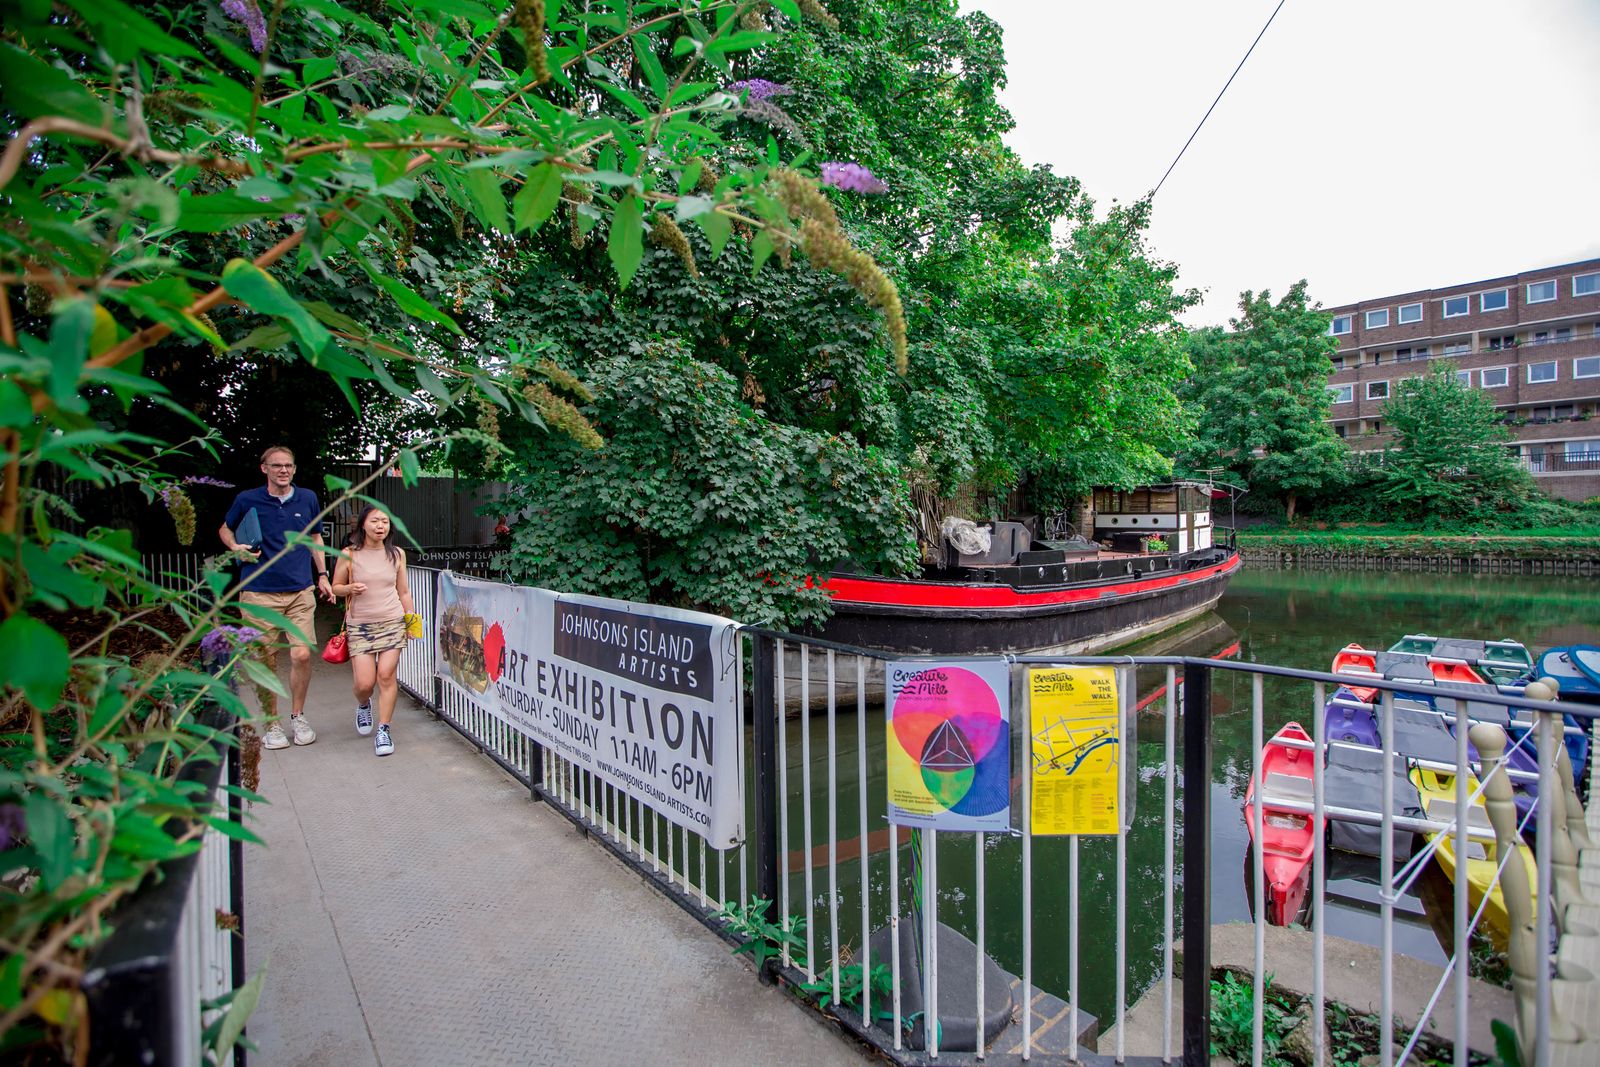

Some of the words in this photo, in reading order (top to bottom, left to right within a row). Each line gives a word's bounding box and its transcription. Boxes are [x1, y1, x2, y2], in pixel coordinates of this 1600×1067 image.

[417, 551, 471, 562] JOHNSONS
[560, 612, 628, 649] JOHNSONS
[633, 626, 694, 665] ISLAND
[618, 652, 699, 688] ARTISTS
[892, 669, 948, 682] Creative
[1033, 672, 1074, 683] Creative
[918, 682, 948, 695] Mile
[1052, 682, 1074, 692] Mile
[497, 645, 529, 687] ART
[537, 660, 714, 767] EXHIBITION
[496, 681, 543, 721] SATURDAY
[552, 706, 599, 751] SUNDAY
[610, 735, 657, 779] 11AM
[671, 762, 713, 808] 6PM
[644, 782, 667, 803] ISLAND
